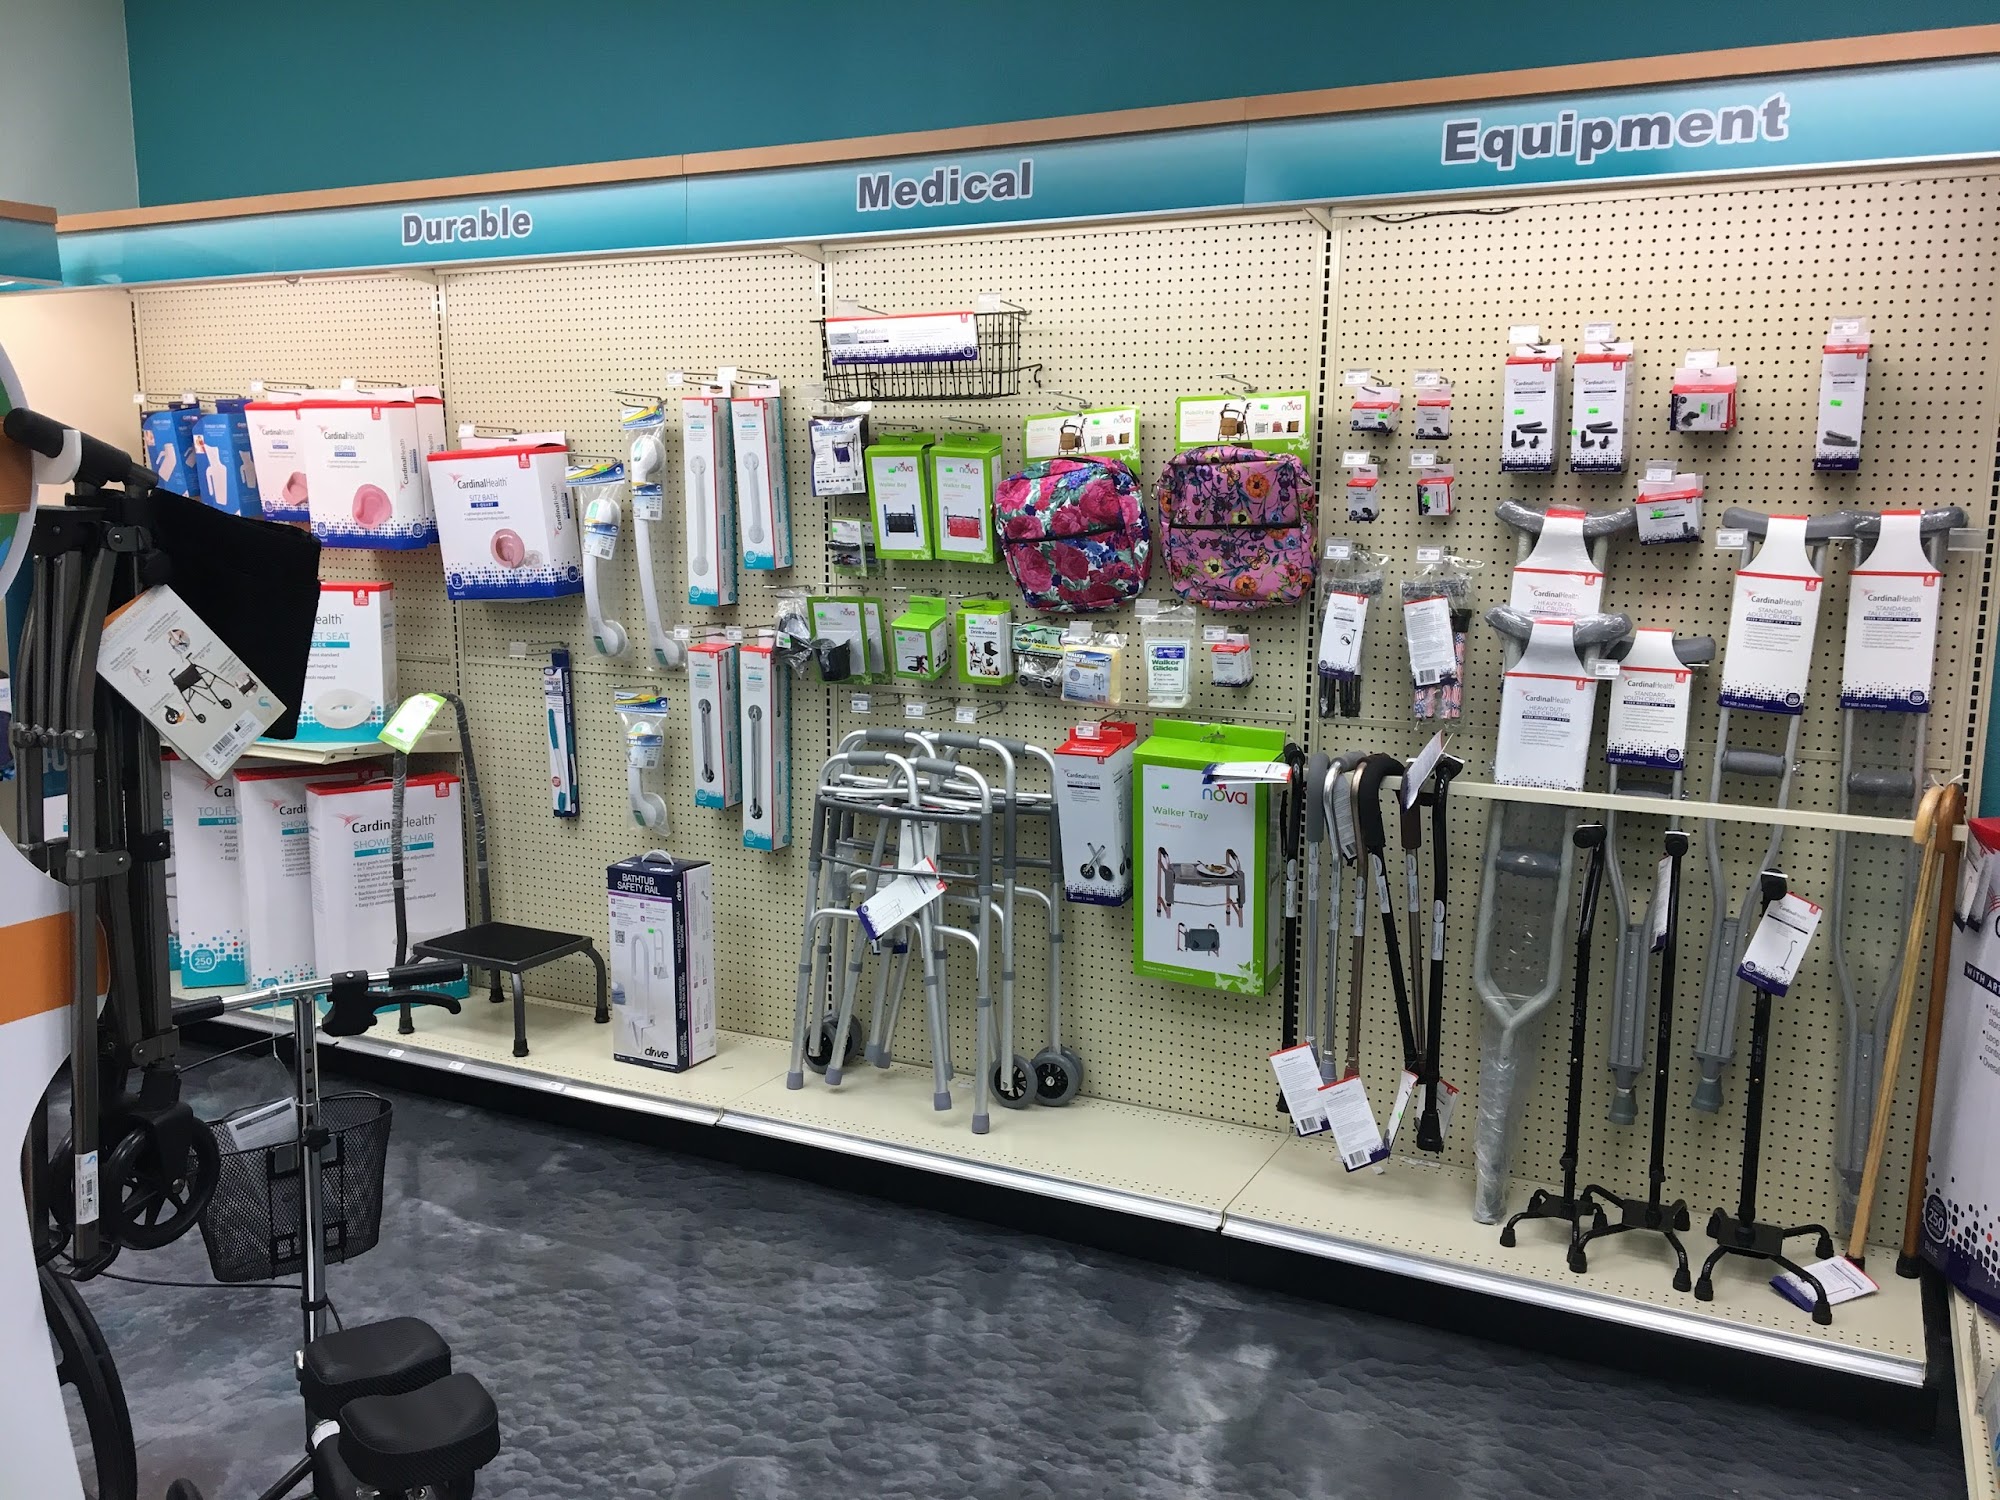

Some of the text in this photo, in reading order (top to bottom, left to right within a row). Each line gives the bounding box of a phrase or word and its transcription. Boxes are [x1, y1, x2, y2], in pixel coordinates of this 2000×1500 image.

[1442, 93, 1789, 169] Equipment
[857, 161, 1033, 212] Medical
[402, 207, 532, 245] Durable
[1281, 402, 1301, 411] nova
[1113, 415, 1131, 424] nova
[324, 431, 364, 440] CardinalHealth
[894, 463, 914, 473] nova
[959, 465, 979, 475] nova
[457, 478, 508, 489] CardinalHealth
[554, 483, 562, 531] CardinalHealth
[1533, 589, 1579, 600] CardinalHealth
[1867, 594, 1921, 603] CardinalHealth
[1751, 595, 1802, 607] CardinalHealth
[1758, 606, 1793, 615] STANDARD
[1767, 613, 1803, 621] CRUTCHES
[326, 632, 350, 641] SEAT
[1015, 636, 1048, 646] walkerballs
[1627, 680, 1675, 690] CardinalHealth
[1525, 694, 1571, 704] CardinalHealth
[1634, 690, 1667, 698] STANDARD
[1202, 785, 1248, 805] nova
[1152, 805, 1209, 821] Walker Tray
[402, 833, 435, 844] CHAIR
[621, 873, 655, 885] BATHTUB
[617, 881, 661, 895] SAFETY RAIL
[194, 957, 212, 966] 250
[1967, 965, 1985, 984] WITH
[644, 1046, 669, 1060] drive
[1927, 1208, 1945, 1232] 250
[1924, 1240, 1939, 1259] BLUE
